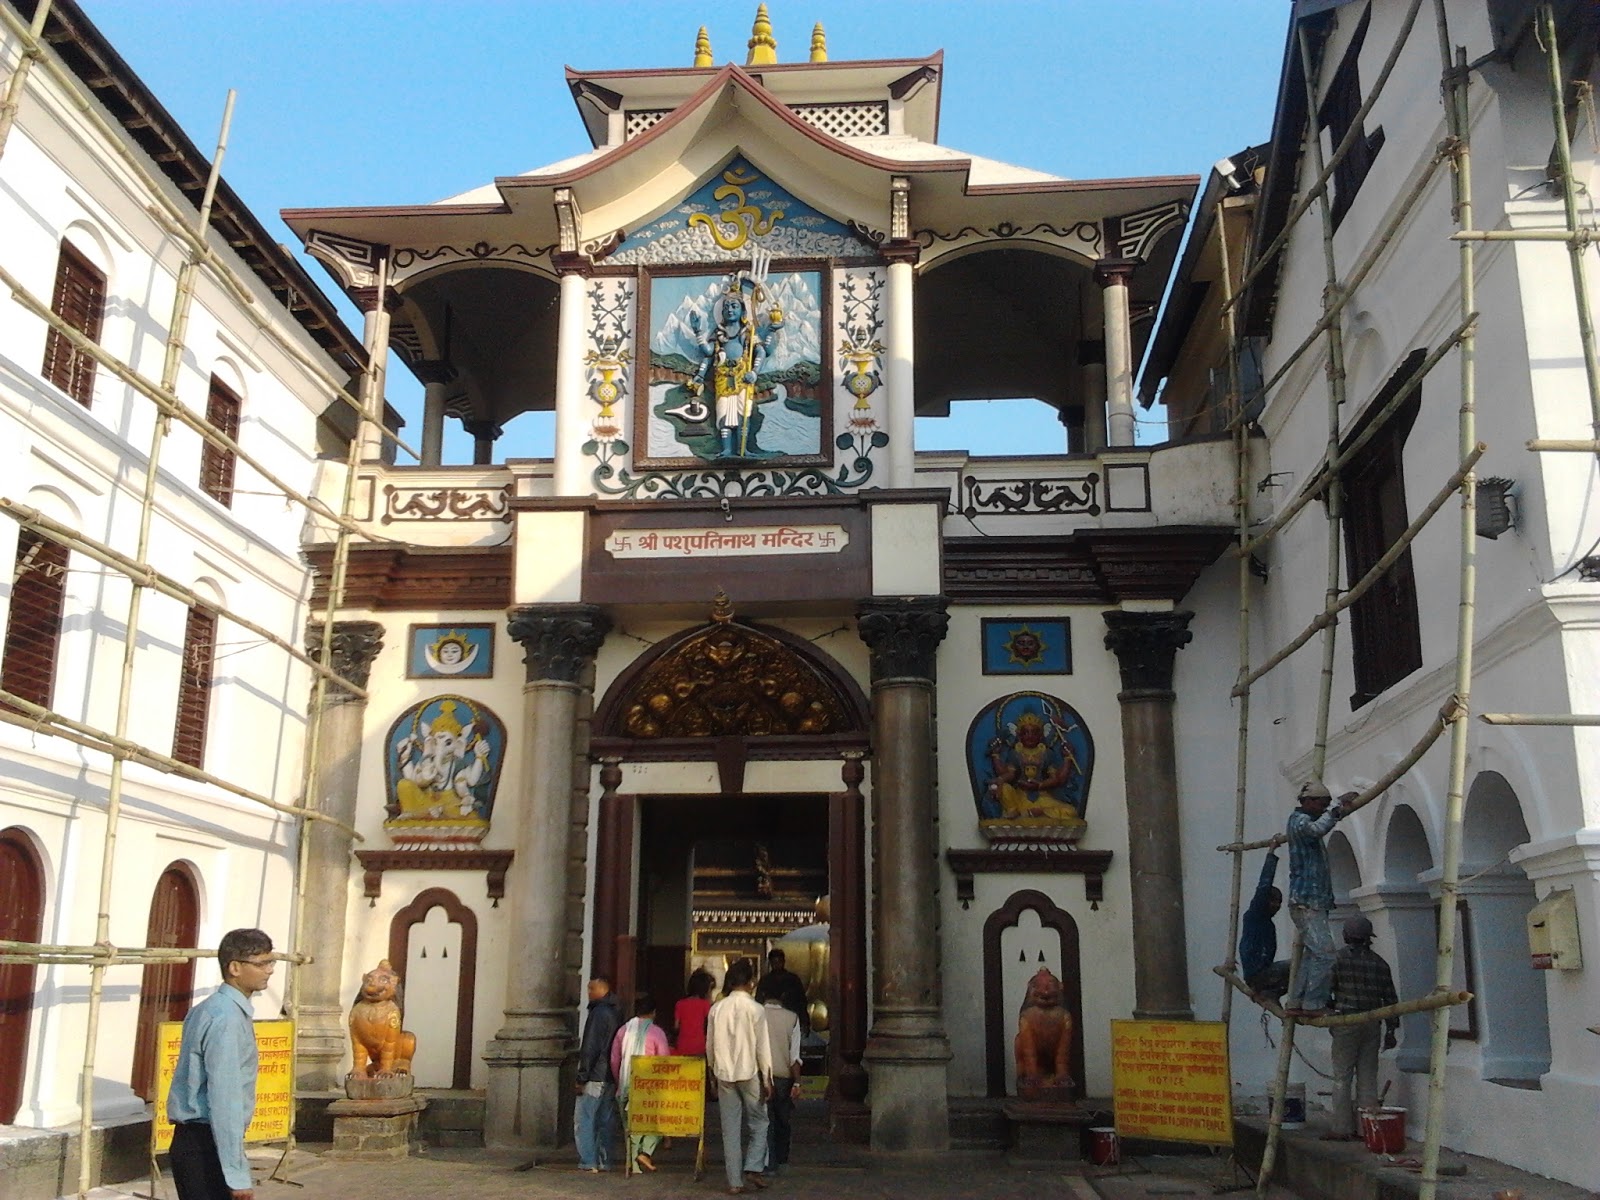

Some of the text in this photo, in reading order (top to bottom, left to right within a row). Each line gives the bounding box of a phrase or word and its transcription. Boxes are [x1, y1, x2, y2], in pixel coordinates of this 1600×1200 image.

[638, 527, 814, 554] श्री पशुपतिनाथ मन्दिर
[1148, 1076, 1185, 1087] NOTICE
[642, 1100, 691, 1110] ENTRANCE
